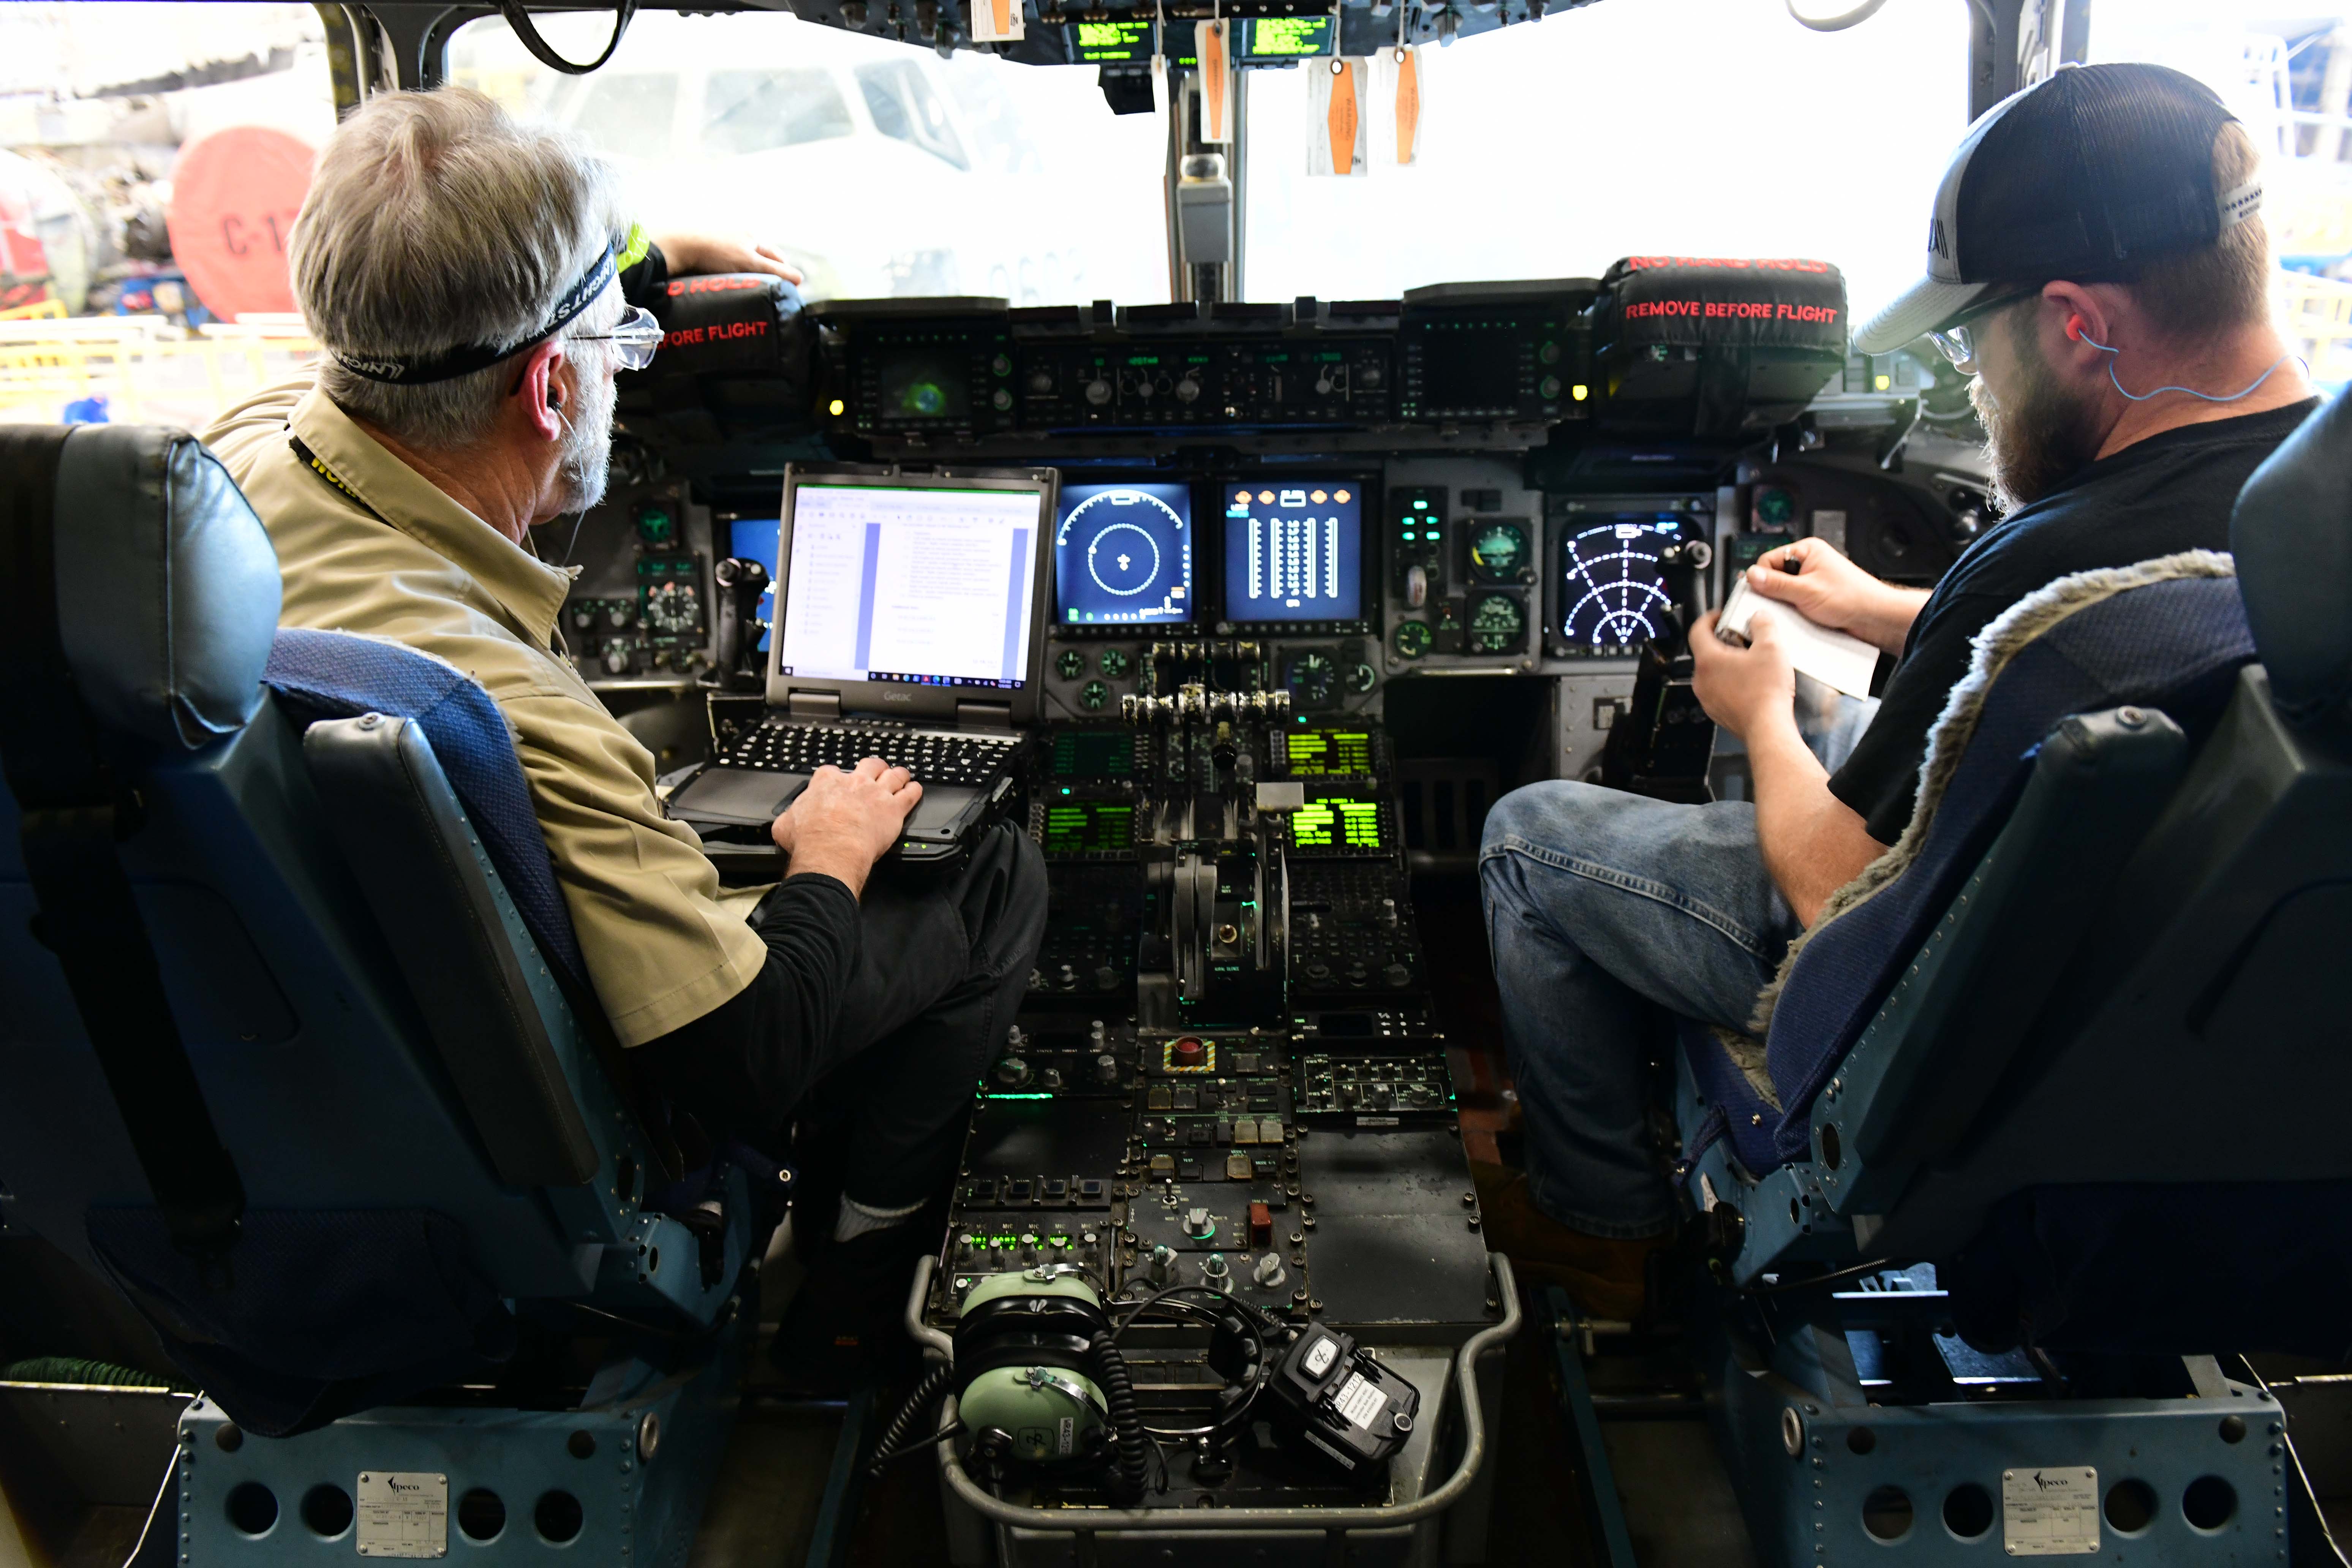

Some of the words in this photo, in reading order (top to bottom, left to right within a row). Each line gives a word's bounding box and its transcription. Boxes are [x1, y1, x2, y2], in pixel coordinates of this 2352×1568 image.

[224, 210, 299, 255] C-1
[1630, 256, 1670, 270] NO
[1757, 258, 1828, 274] HOLD
[689, 277, 760, 294] HOLD
[1626, 300, 1700, 319] REMOVE
[1705, 302, 1772, 318] BEFORE
[1777, 304, 1837, 324] FLIGHT
[657, 328, 705, 349] FORE
[708, 321, 768, 341] FLIGHT
[884, 690, 911, 702] Getac
